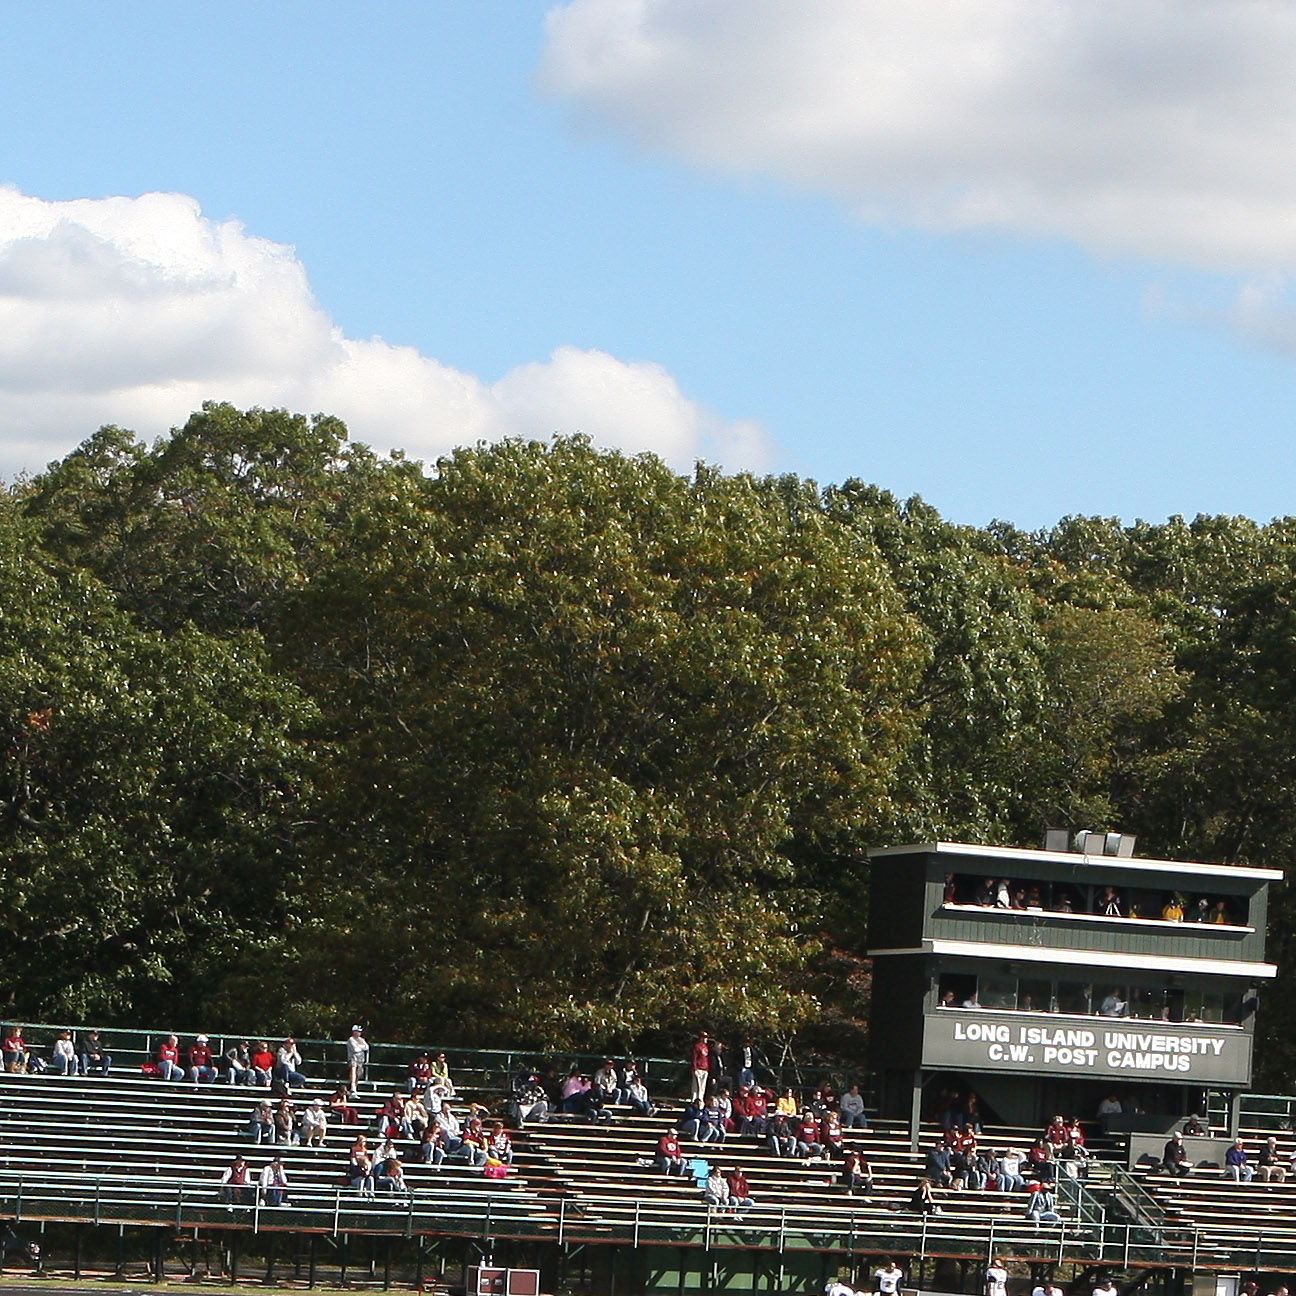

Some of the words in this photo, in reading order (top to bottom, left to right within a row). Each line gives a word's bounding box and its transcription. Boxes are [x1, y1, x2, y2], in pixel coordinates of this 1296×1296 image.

[954, 1023, 1010, 1043] LONG
[1020, 1027, 1095, 1047] ISLAND
[1104, 1032, 1225, 1055] UNIVERSITY
[988, 1044, 1034, 1063] C.W.
[1044, 1047, 1098, 1066] POST
[1107, 1051, 1191, 1072] CAMPUS
